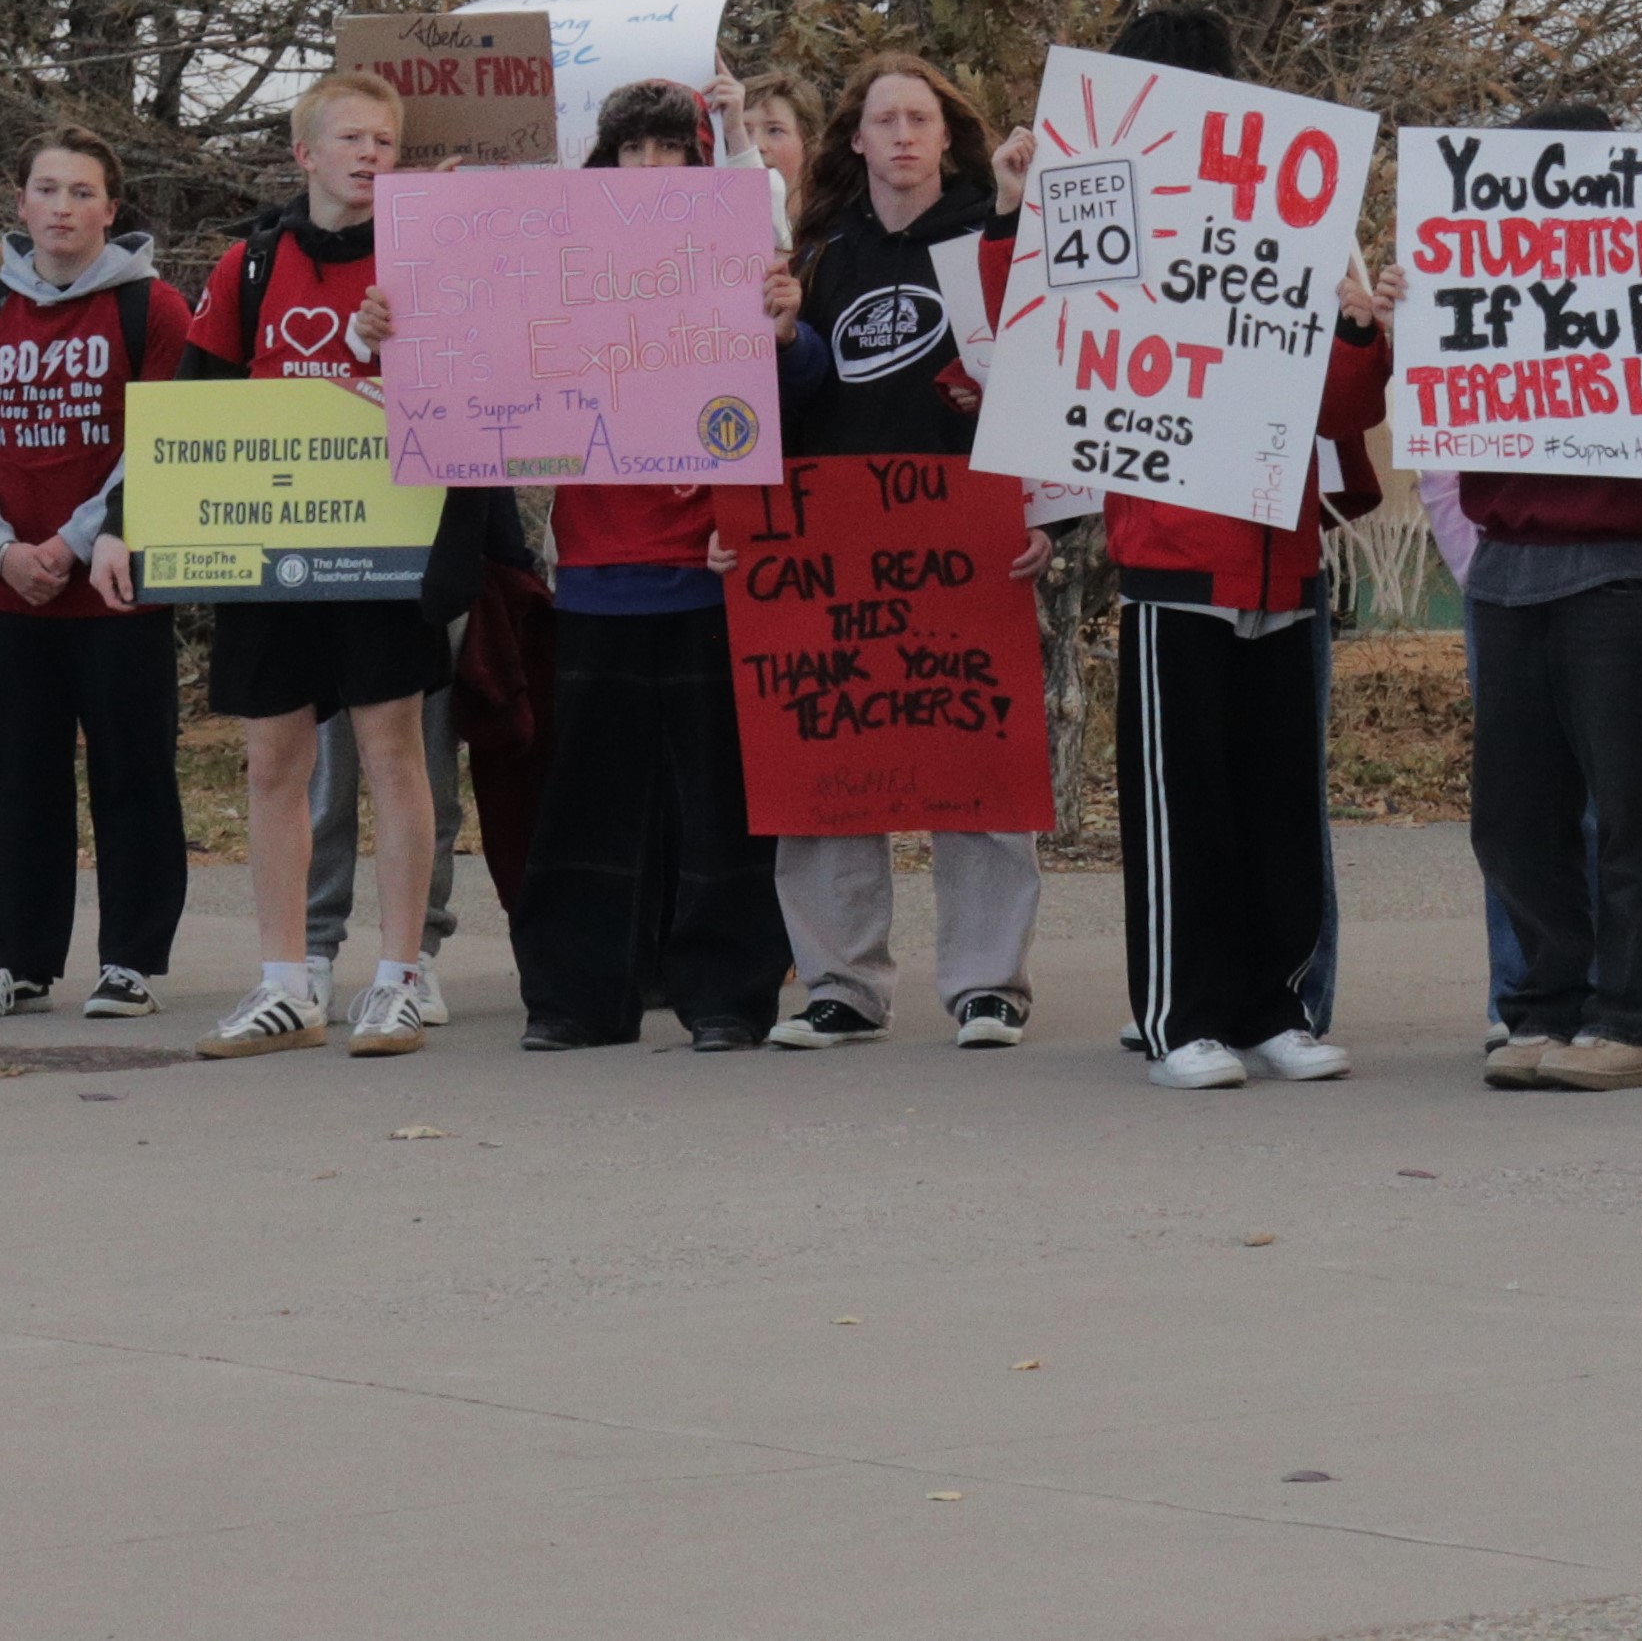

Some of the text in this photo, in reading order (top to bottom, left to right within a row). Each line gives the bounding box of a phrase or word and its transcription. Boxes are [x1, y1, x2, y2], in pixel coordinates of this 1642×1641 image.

[399, 16, 479, 51] Alberta
[1049, 175, 1125, 200] SPEED
[1198, 110, 1340, 229] 40
[1436, 135, 1528, 213] You
[391, 185, 572, 250] Forced
[1057, 200, 1117, 224] LIMIT
[1053, 225, 1131, 269] 40
[1202, 216, 1280, 263] is a
[1413, 216, 1635, 279] STUDENTS
[561, 233, 766, 305] Education
[1227, 306, 1324, 357] limit
[1434, 284, 1521, 352] If
[1528, 279, 1621, 352] You
[282, 361, 351, 378] PUBLIC
[394, 309, 773, 412] It's Exploitation
[1076, 328, 1224, 399] NOT
[22, 385, 64, 401] Those
[70, 382, 103, 398] Who
[37, 404, 53, 420] To
[59, 401, 101, 419] Teach
[399, 389, 599, 424] We Support The
[1407, 352, 1620, 427] TEACHERS
[81, 420, 110, 445] You
[1066, 405, 1087, 427] a
[233, 437, 302, 462] PUBLIC
[279, 499, 367, 524] ALBERTA
[751, 460, 949, 542] IF YOU
[184, 552, 237, 567] StopThe
[184, 567, 253, 581] Excuses.ca
[312, 558, 374, 569] The Alberta
[363, 570, 424, 583] Association
[747, 550, 975, 602] CAN READ
[742, 645, 999, 698] THANK YOUR
[784, 687, 1012, 741] TEACHERS!
